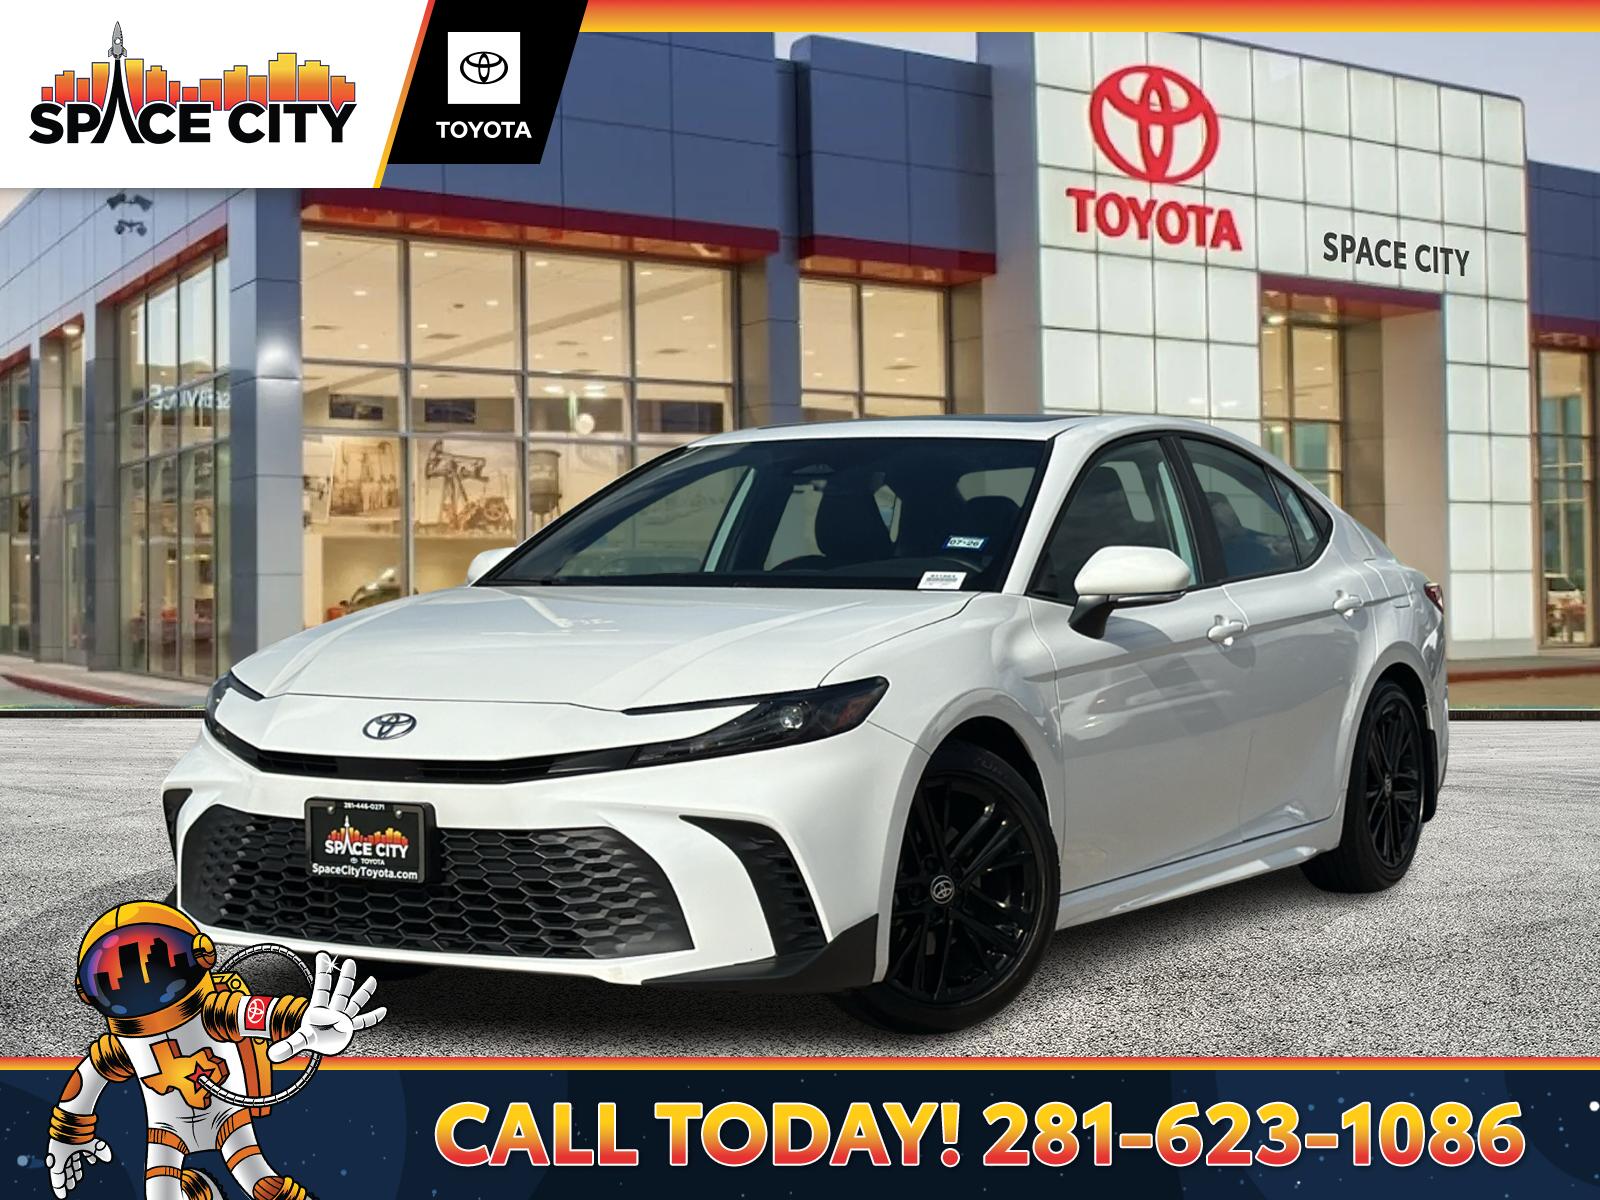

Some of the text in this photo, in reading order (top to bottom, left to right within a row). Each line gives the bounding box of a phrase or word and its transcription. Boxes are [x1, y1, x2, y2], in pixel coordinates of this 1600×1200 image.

[1065, 188, 1243, 252] TOYOTA
[1322, 232, 1471, 277] SPACE CITY
[324, 839, 409, 859] SPACE CITY
[312, 862, 418, 880] SpaceCityToyota.com
[360, 857, 386, 866] TOYOTA
